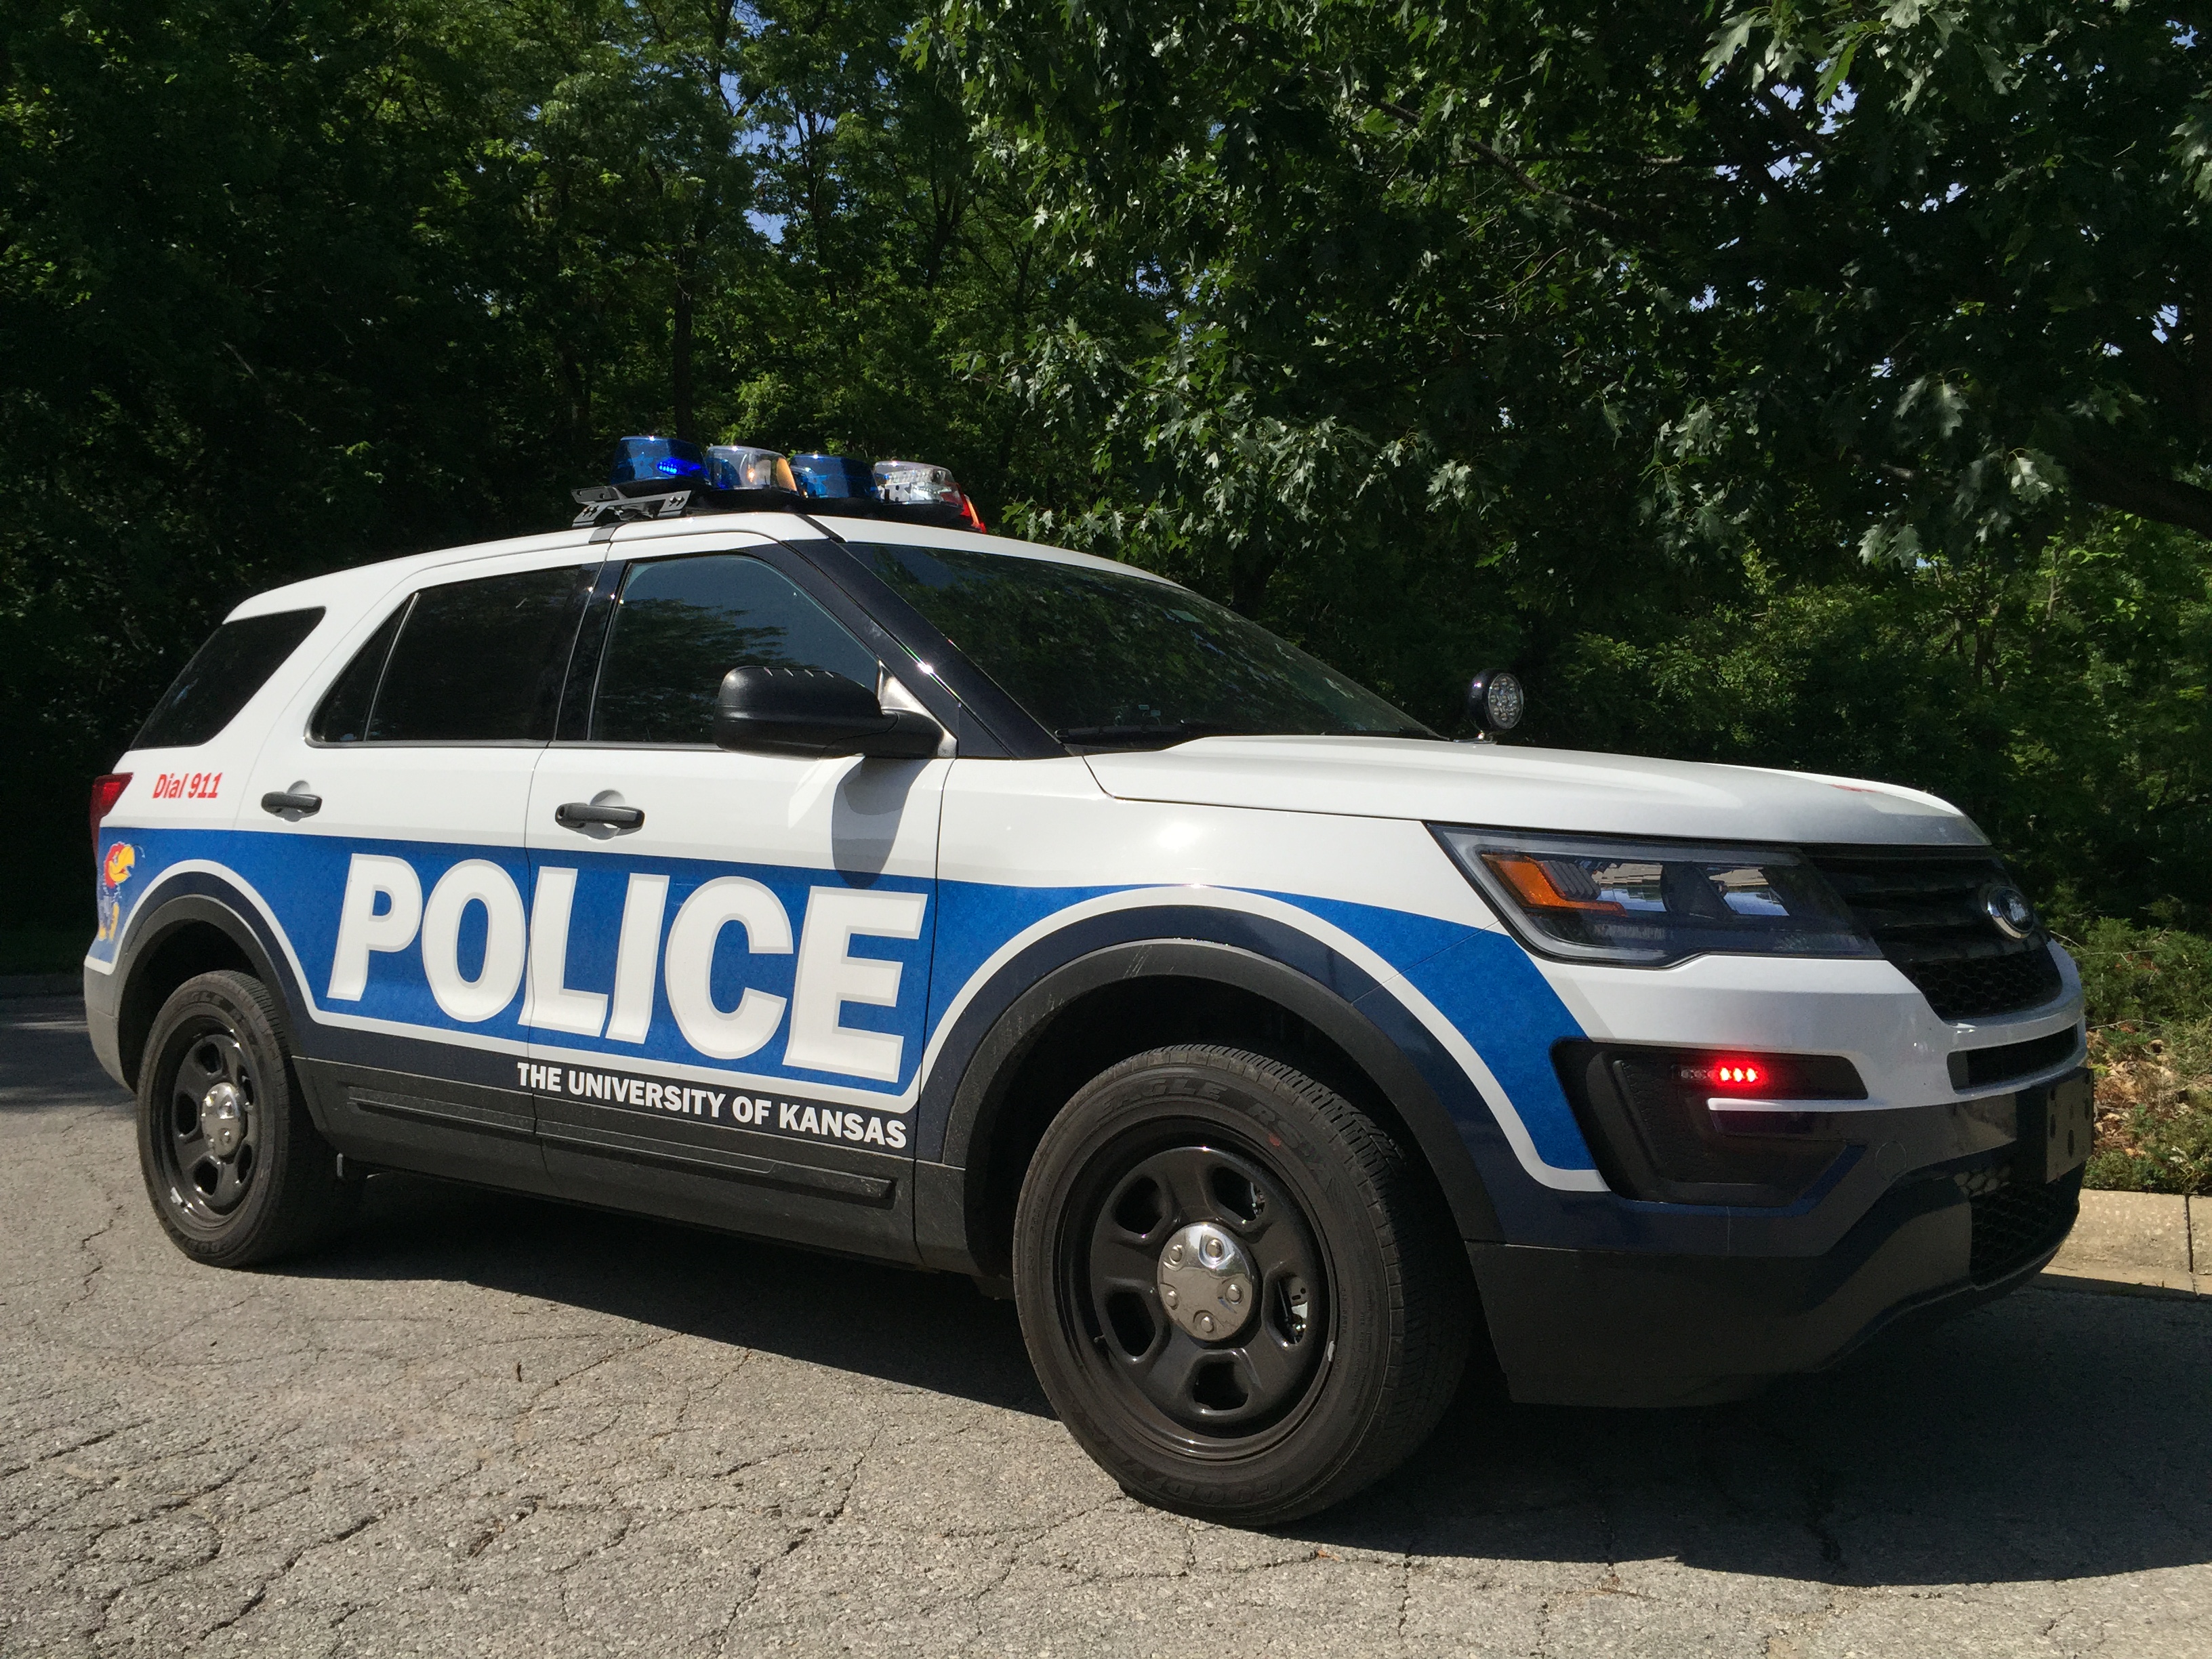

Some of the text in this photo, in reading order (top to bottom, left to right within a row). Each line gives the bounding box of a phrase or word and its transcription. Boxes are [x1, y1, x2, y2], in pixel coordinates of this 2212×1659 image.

[152, 773, 222, 798] Dial 911
[327, 853, 928, 1083] POLICE
[517, 1062, 907, 1148] THE UNIVERSITY OF KANSAS
[1096, 1079, 1228, 1120] EAGLE
